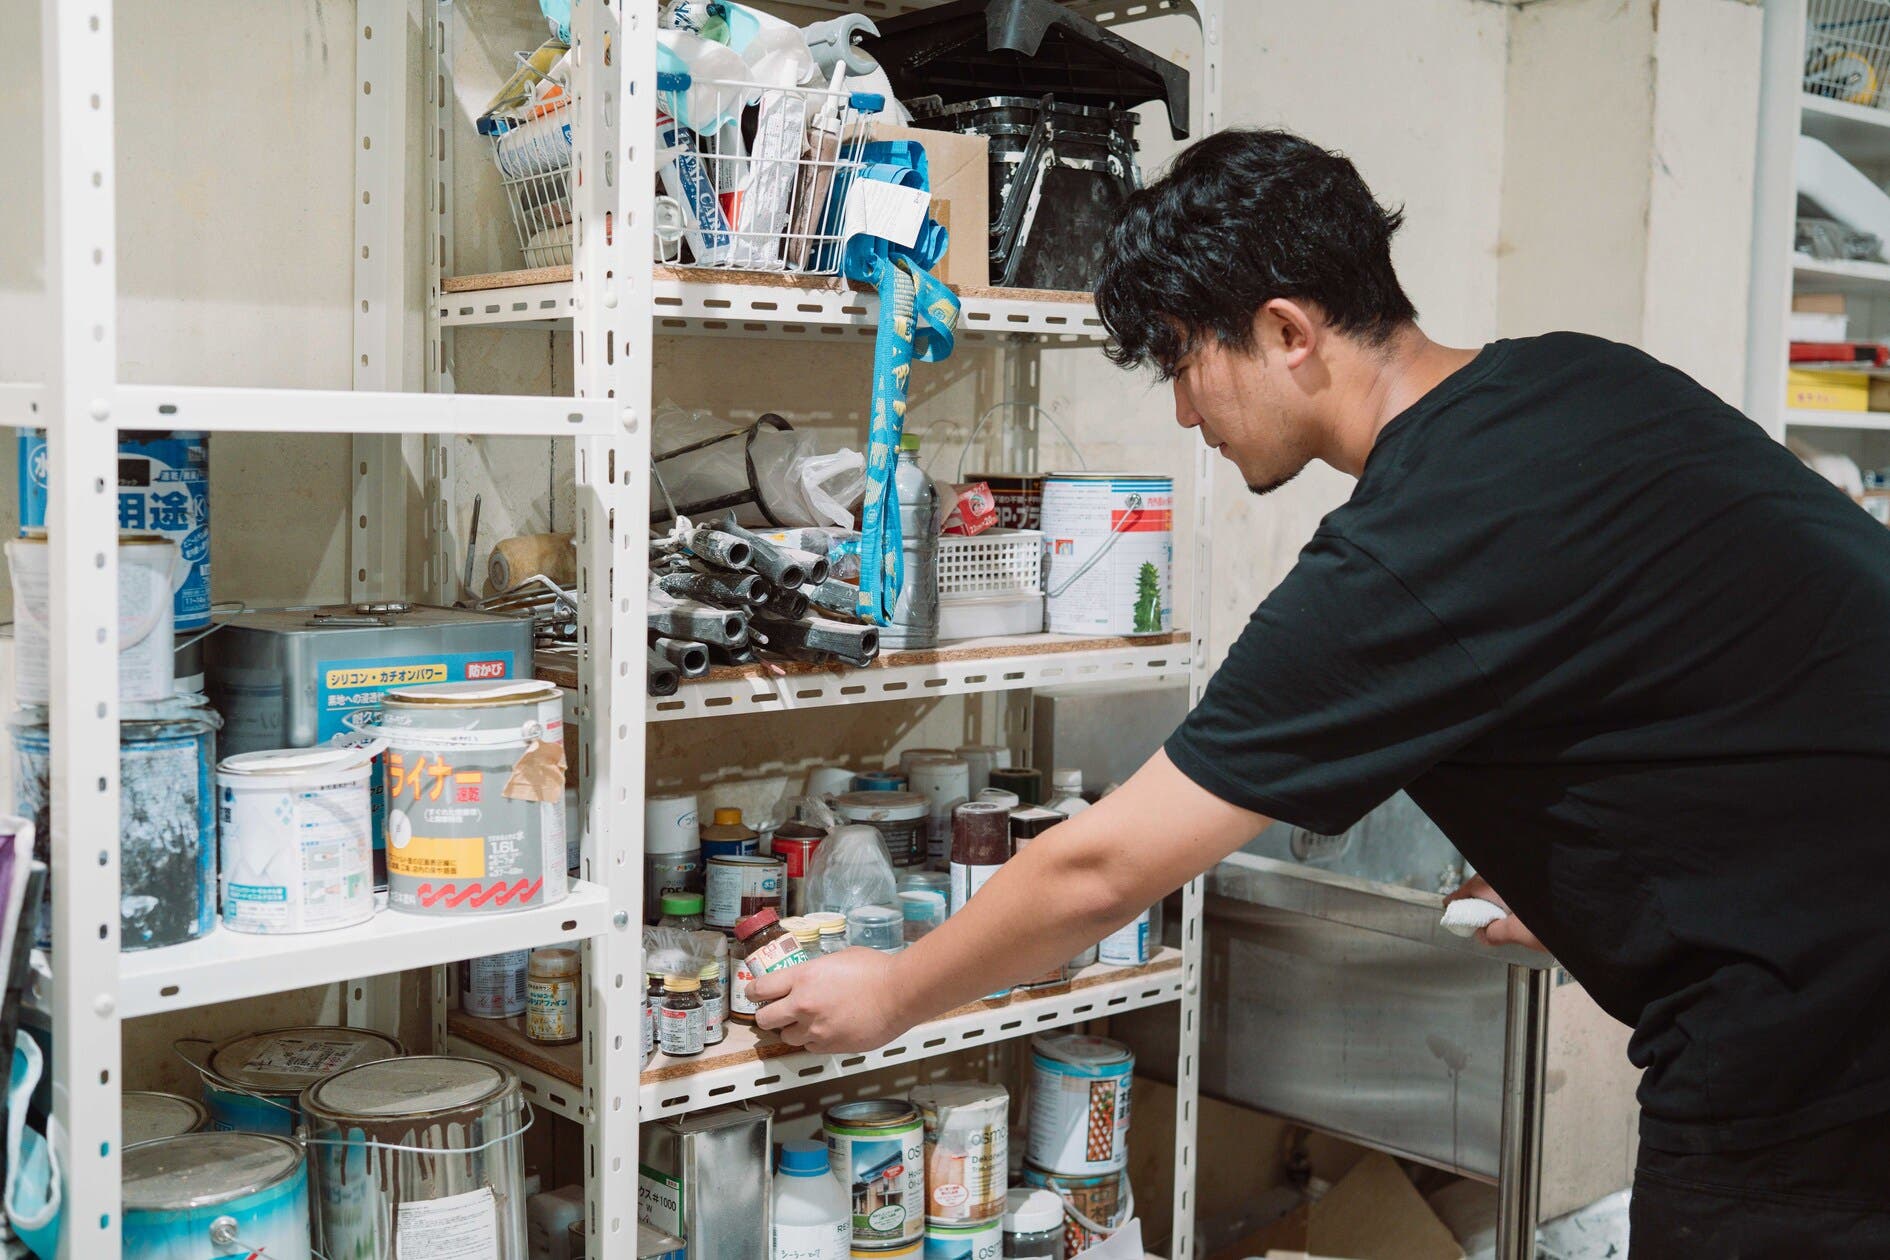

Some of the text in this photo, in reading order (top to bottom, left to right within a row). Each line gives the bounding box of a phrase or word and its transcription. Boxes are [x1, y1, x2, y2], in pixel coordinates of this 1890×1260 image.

[331, 669, 443, 686] シリコン・カチオンパワー
[468, 663, 503, 678] 防かび
